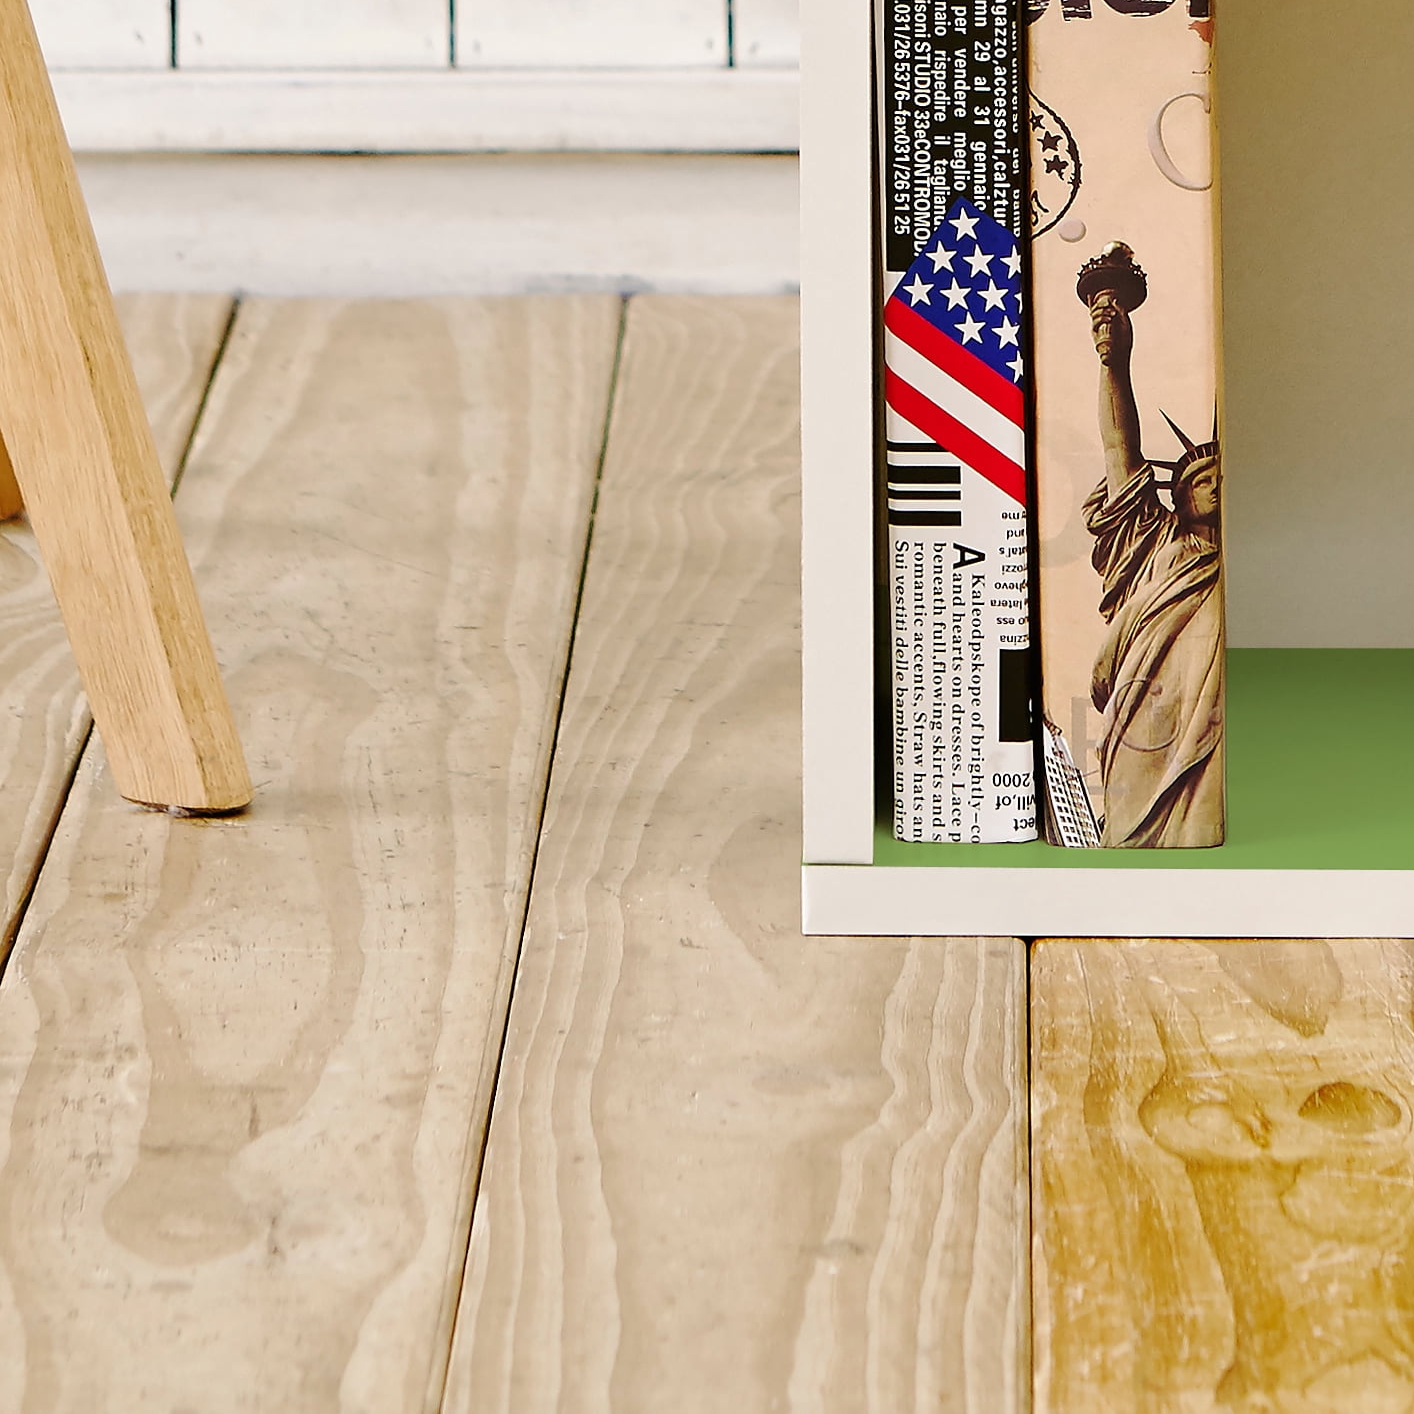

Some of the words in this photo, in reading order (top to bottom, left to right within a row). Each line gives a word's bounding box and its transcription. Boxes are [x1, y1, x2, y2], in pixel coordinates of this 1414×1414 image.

[951, 6, 967, 34] per
[974, 41, 991, 62] 29
[914, 41, 931, 106] STUDIO
[931, 50, 951, 122] rispedire
[954, 49, 971, 117] vendere
[974, 76, 991, 91] al
[974, 106, 990, 125] 31
[934, 136, 950, 145] il
[950, 132, 970, 191] meglio
[894, 193, 910, 210] 51
[894, 216, 910, 234] 25
[895, 541, 909, 569] Sui
[953, 543, 985, 570] A
[914, 542, 927, 626] romantic
[933, 543, 946, 615] beneath
[952, 573, 965, 606] and
[895, 576, 907, 631] vestiti
[895, 637, 908, 681] delle
[952, 613, 965, 671] hearts
[968, 575, 984, 706] Kaleodpskope
[912, 633, 926, 706] accents,
[929, 623, 946, 730] full,flowing
[952, 676, 962, 698] on
[896, 688, 908, 766] bambine
[913, 712, 927, 766] Straw
[952, 704, 965, 776] dresses.
[971, 712, 984, 731] of
[896, 772, 904, 792] un
[933, 736, 945, 789] skirts
[993, 773, 1030, 788] 2000
[913, 773, 926, 811] hats
[933, 795, 945, 827] and
[952, 783, 965, 826] Lace
